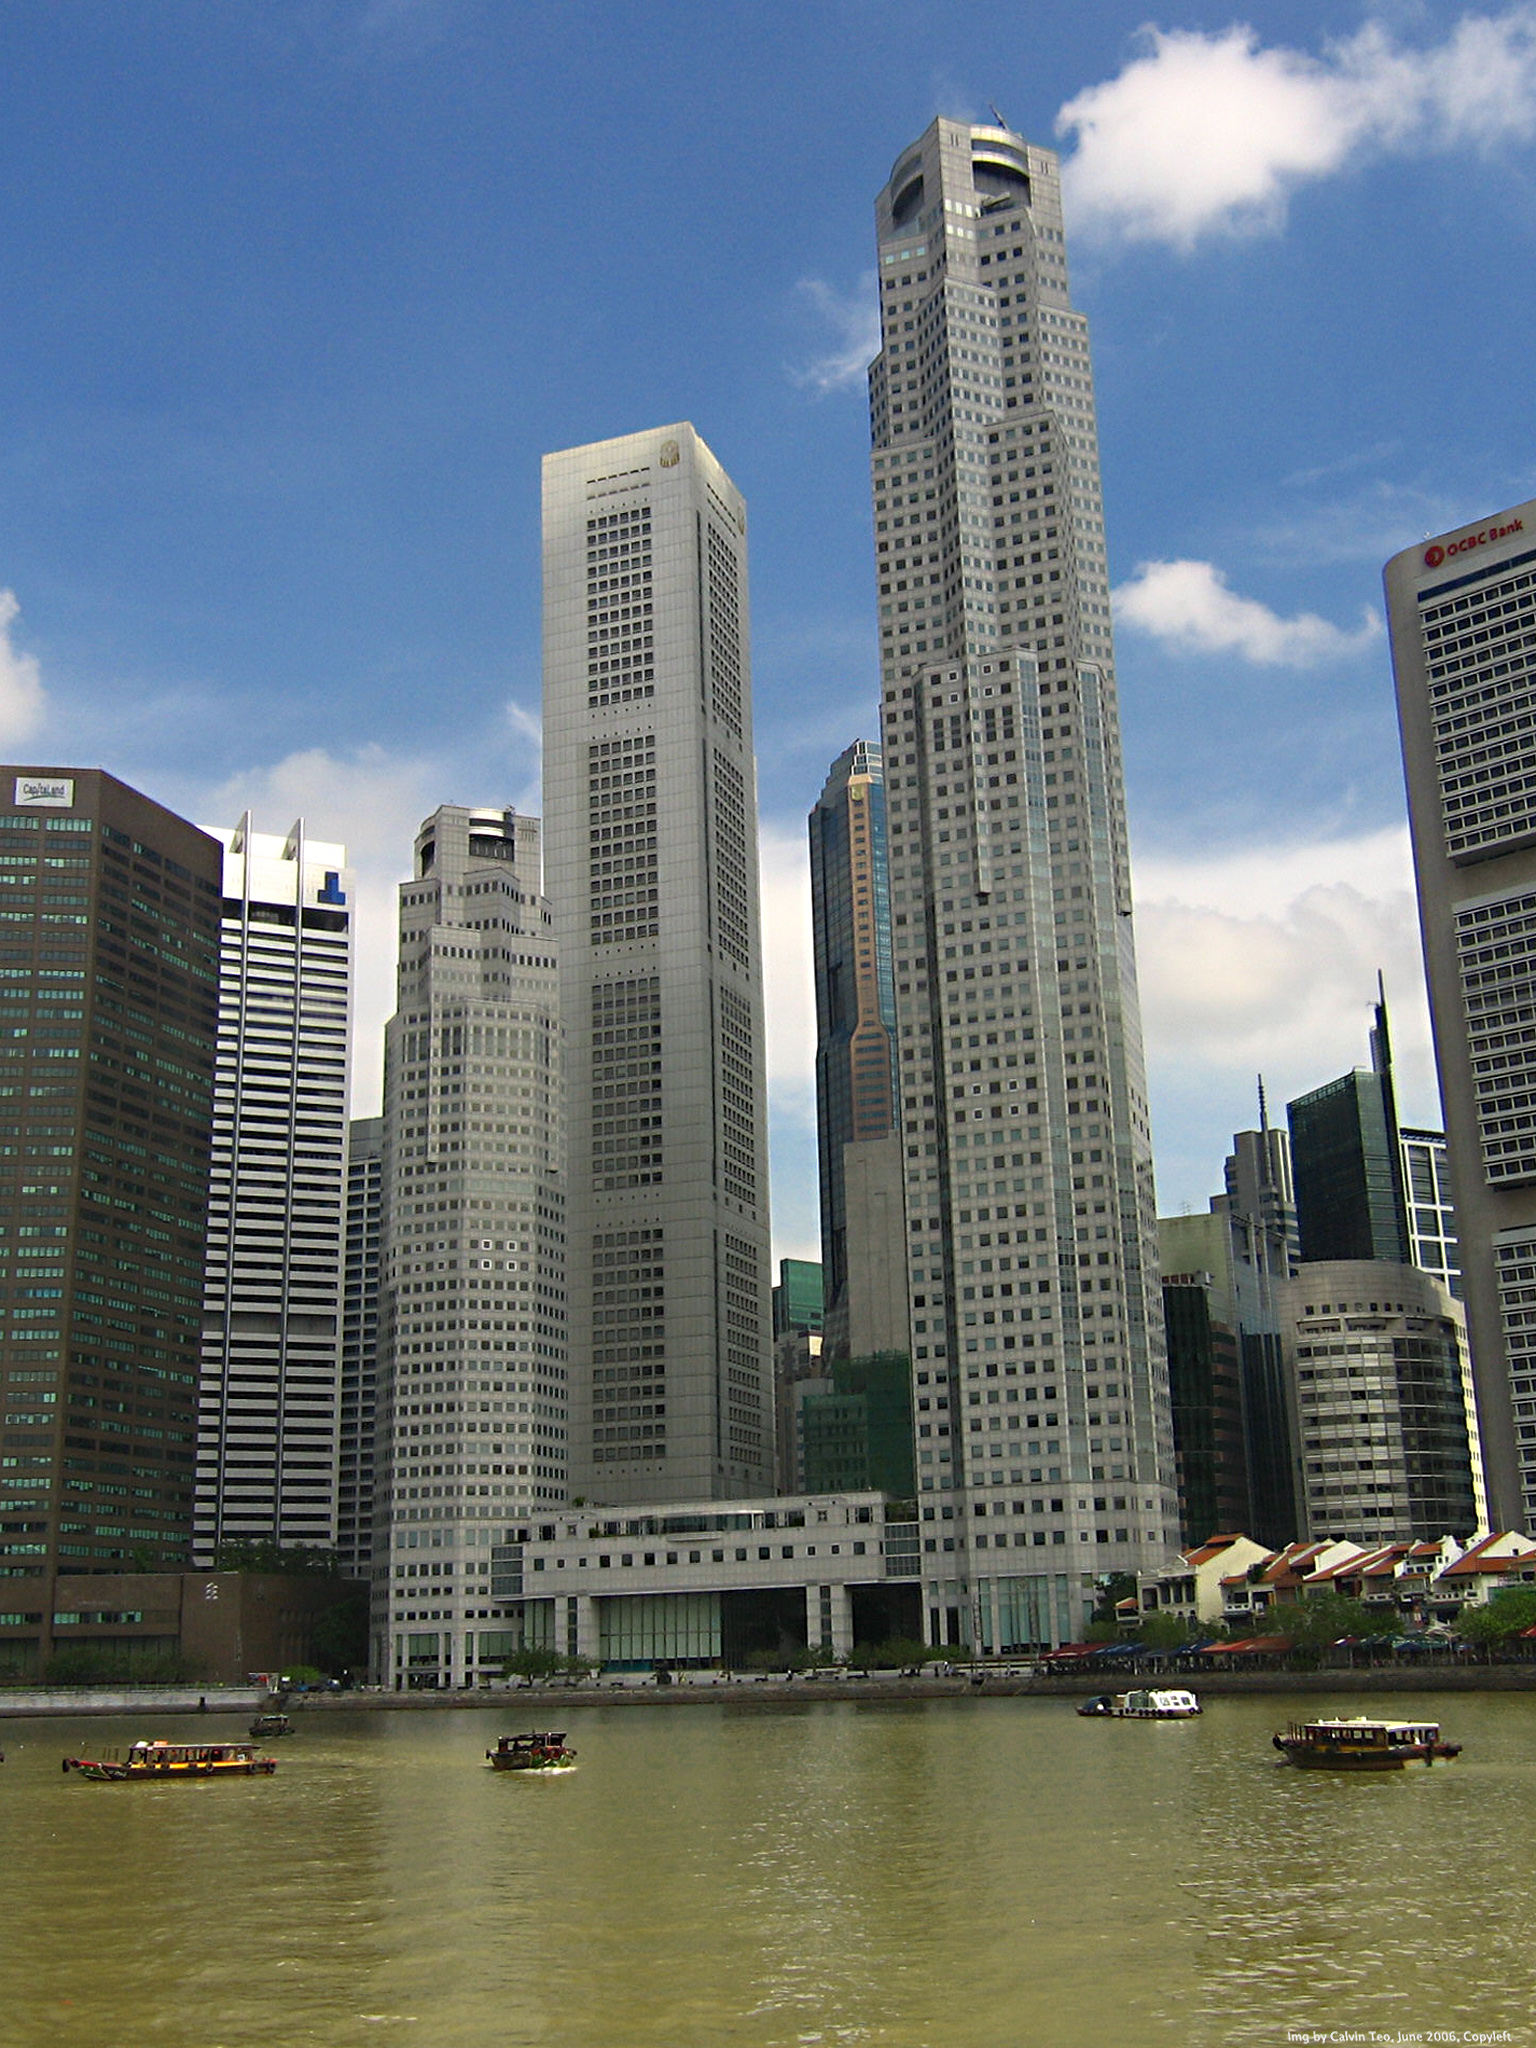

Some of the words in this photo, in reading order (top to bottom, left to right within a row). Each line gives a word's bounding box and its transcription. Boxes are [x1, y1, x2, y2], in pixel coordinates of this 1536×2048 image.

[1447, 532, 1487, 556] OCBC
[1489, 518, 1524, 541] Bank
[23, 782, 65, 796] CapitaLand
